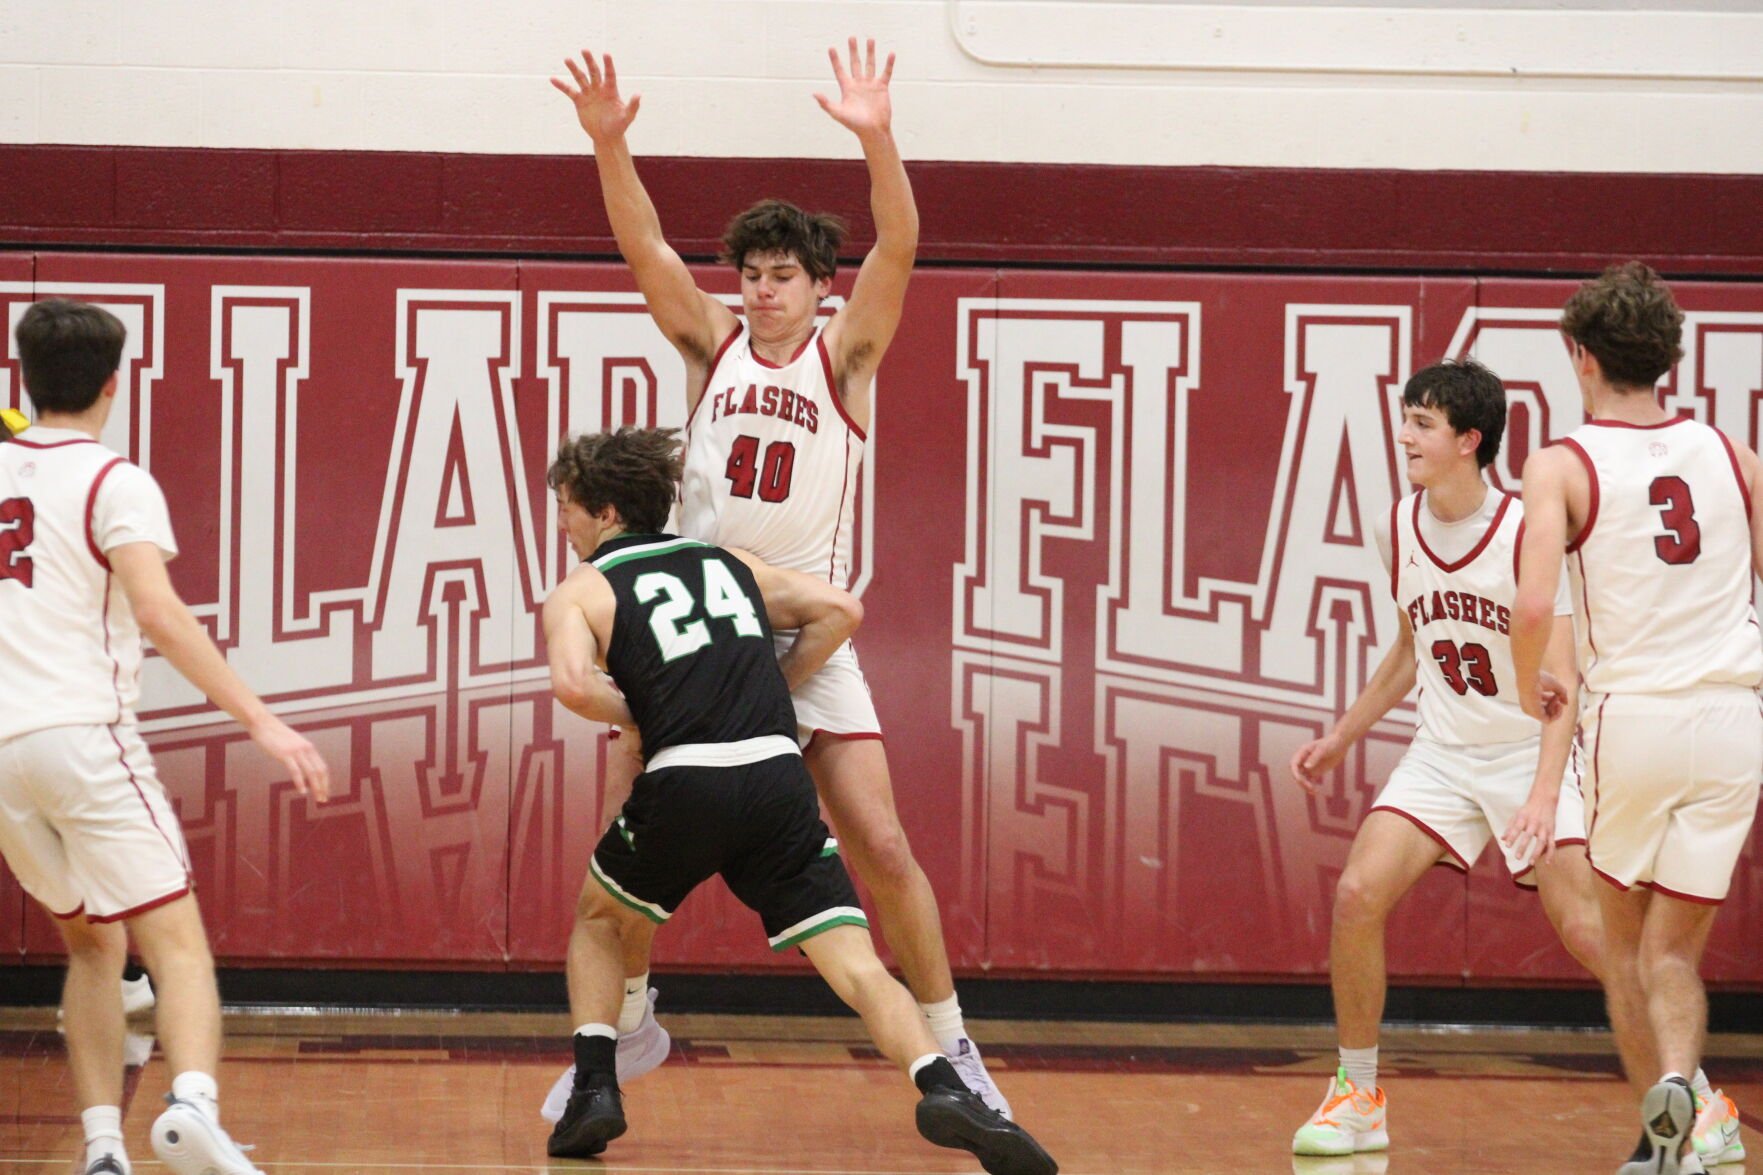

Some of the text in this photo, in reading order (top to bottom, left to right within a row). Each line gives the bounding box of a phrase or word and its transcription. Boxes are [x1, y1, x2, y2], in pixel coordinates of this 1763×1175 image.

[711, 384, 819, 434] FLASHES
[725, 434, 795, 503] 40
[0, 496, 35, 589] 2
[952, 297, 1763, 724] FLA
[1648, 475, 1701, 565] 3
[632, 558, 764, 664] 24
[1407, 590, 1511, 636] FLASHES
[1431, 639, 1498, 696] 33
